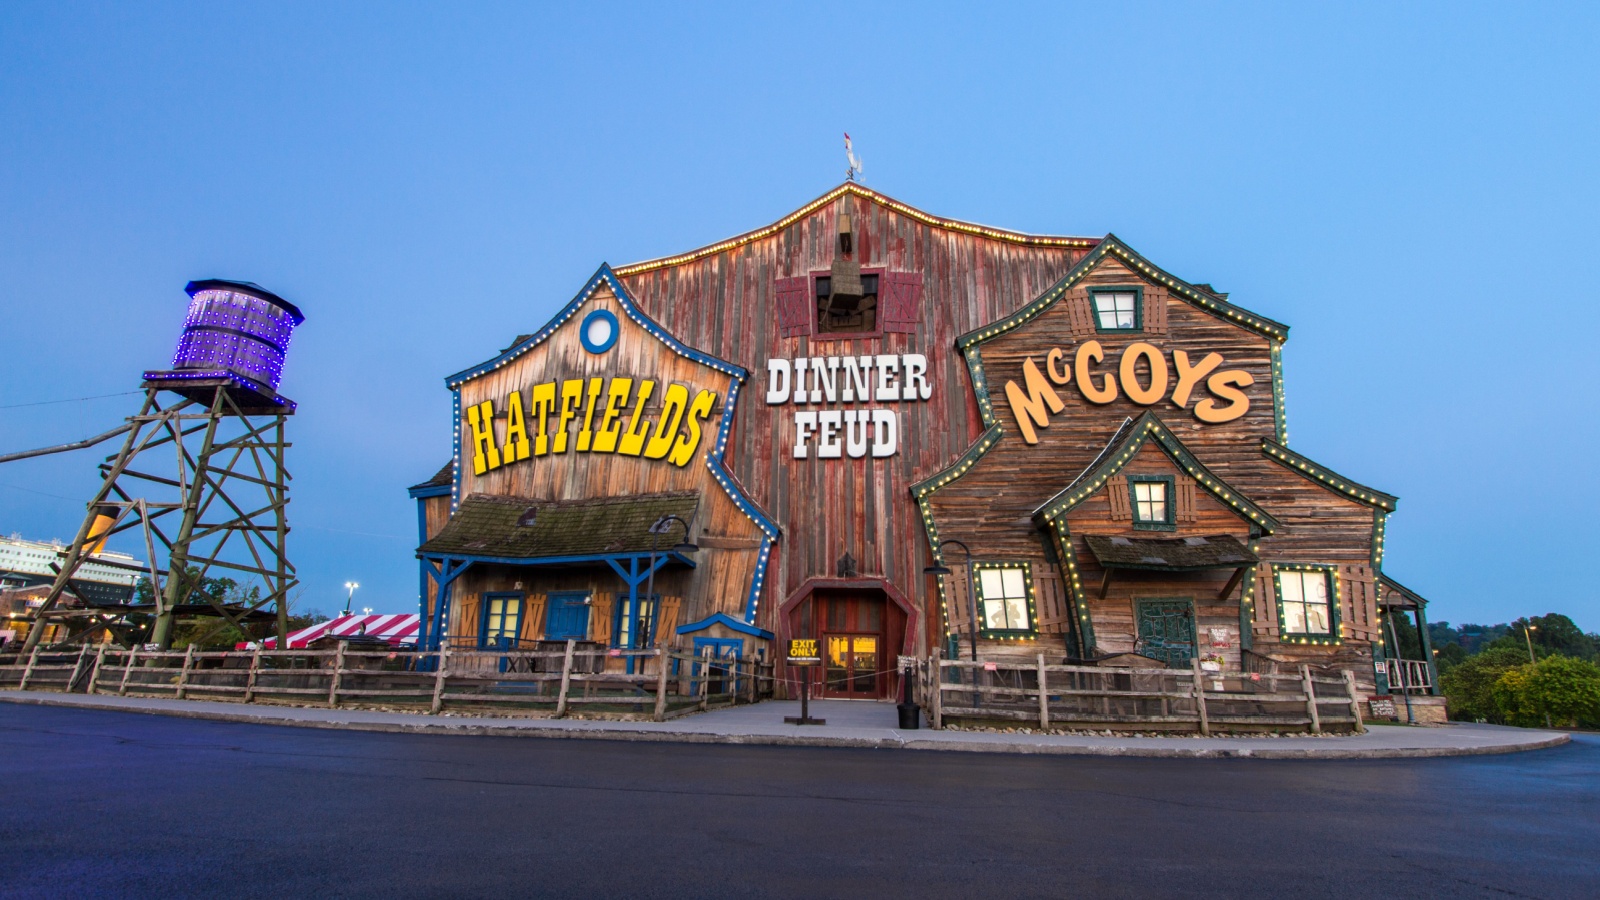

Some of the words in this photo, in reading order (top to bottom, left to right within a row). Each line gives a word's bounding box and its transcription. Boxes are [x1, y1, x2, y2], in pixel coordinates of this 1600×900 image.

[766, 353, 932, 404] DINNER
[1005, 340, 1255, 445] McCOYS
[467, 377, 717, 476] HATFIELDS
[793, 409, 897, 459] FEUD
[790, 648, 818, 656] ONLY
[792, 639, 816, 648] EXIT
